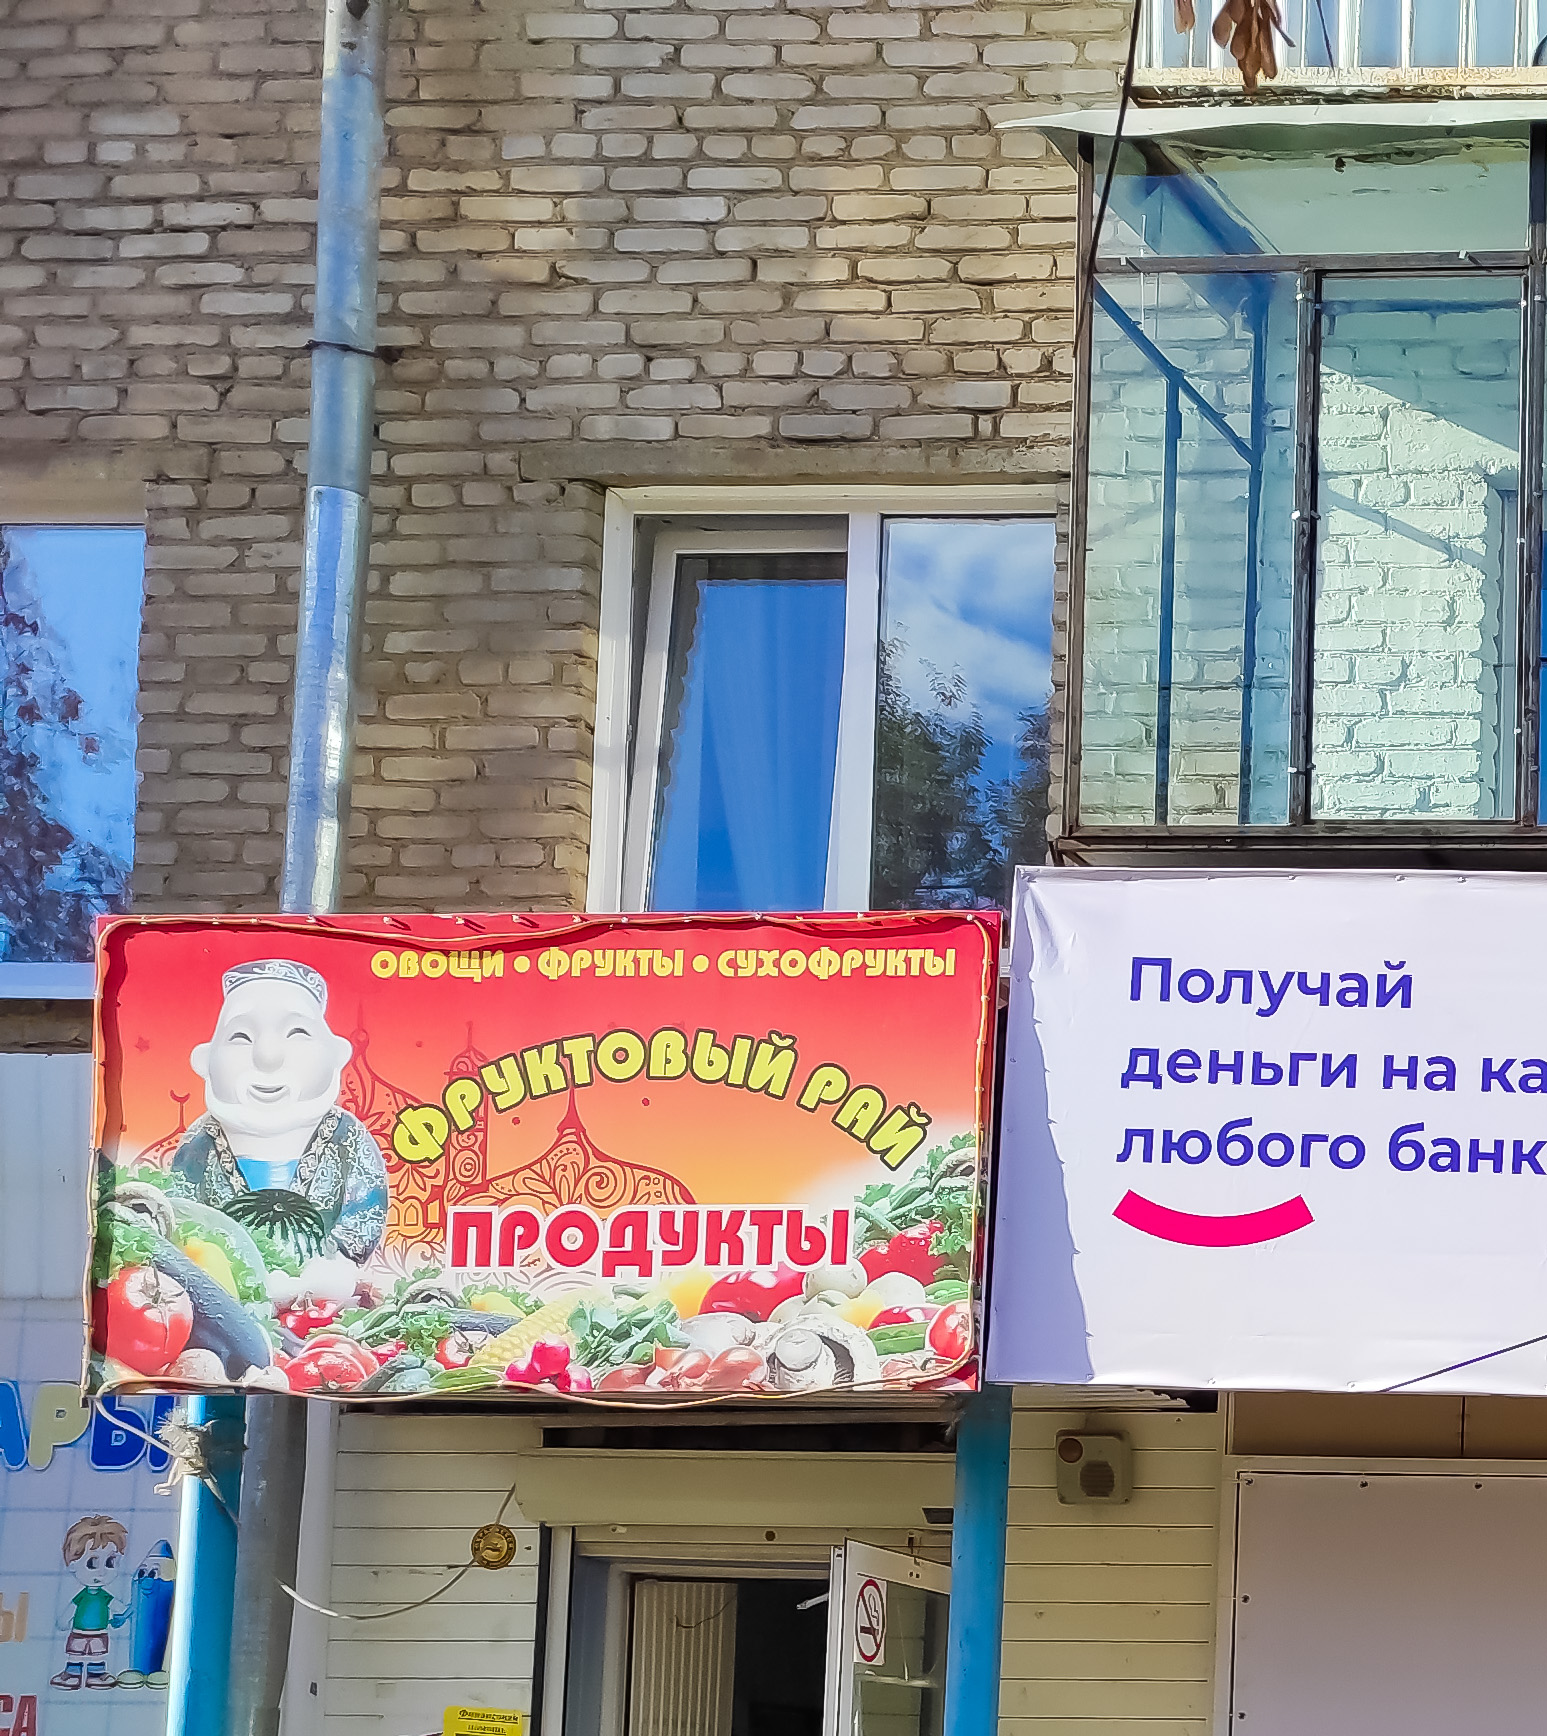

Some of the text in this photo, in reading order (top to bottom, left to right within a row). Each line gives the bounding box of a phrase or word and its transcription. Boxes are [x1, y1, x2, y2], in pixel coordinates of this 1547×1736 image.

[370, 947, 956, 982] ОВОЩИ ФРУКТЫ СУХОФРУКТЫ
[1129, 957, 1413, 1017] Получай
[1121, 1045, 1358, 1092] деньги
[1381, 1054, 1457, 1092] на
[392, 1027, 933, 1170] ФРУКТОВЫЙ РАЙ
[1117, 1118, 1366, 1171] любого
[451, 1209, 850, 1278] ПРОДУКТЫ
